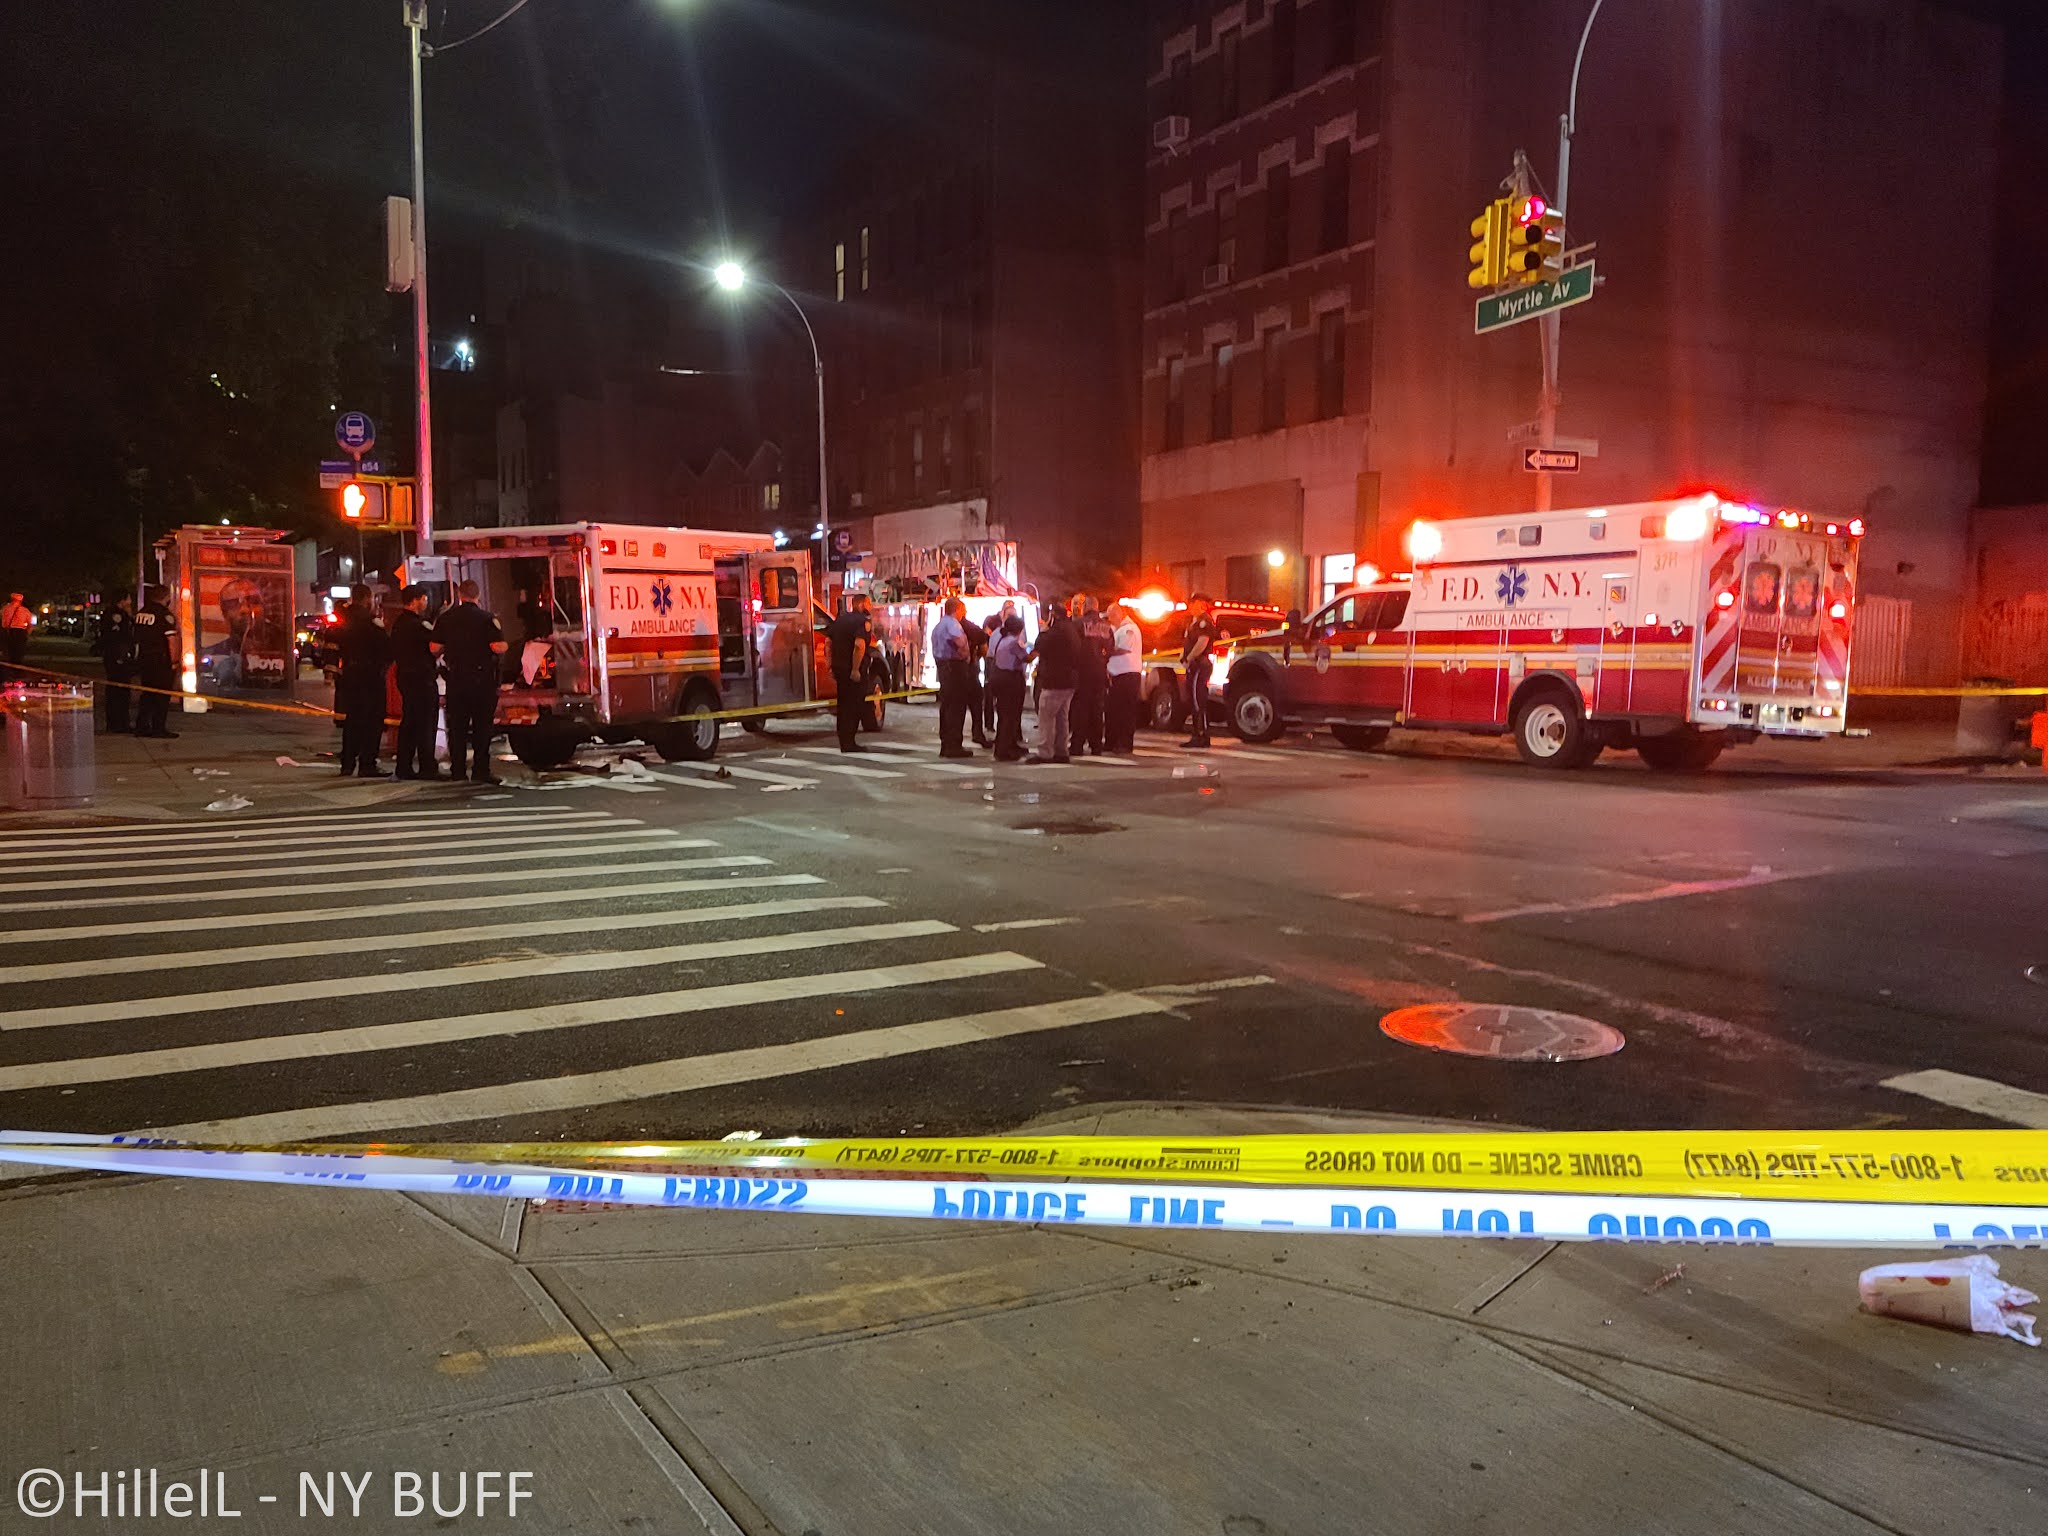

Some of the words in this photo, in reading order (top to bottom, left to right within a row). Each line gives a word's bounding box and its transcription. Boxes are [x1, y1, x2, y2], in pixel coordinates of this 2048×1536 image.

[1498, 289, 1543, 319] Myrtle
[1550, 281, 1570, 302] Av
[1532, 456, 1549, 467] ONE
[1555, 456, 1573, 466] WAY
[1441, 576, 1484, 602] F.D.
[1542, 571, 1591, 598] N.Y.
[609, 585, 644, 611] F.D.
[680, 586, 711, 610] N.Y.
[631, 618, 696, 636] AMBULANCE
[1466, 611, 1545, 628] AMBULANCE
